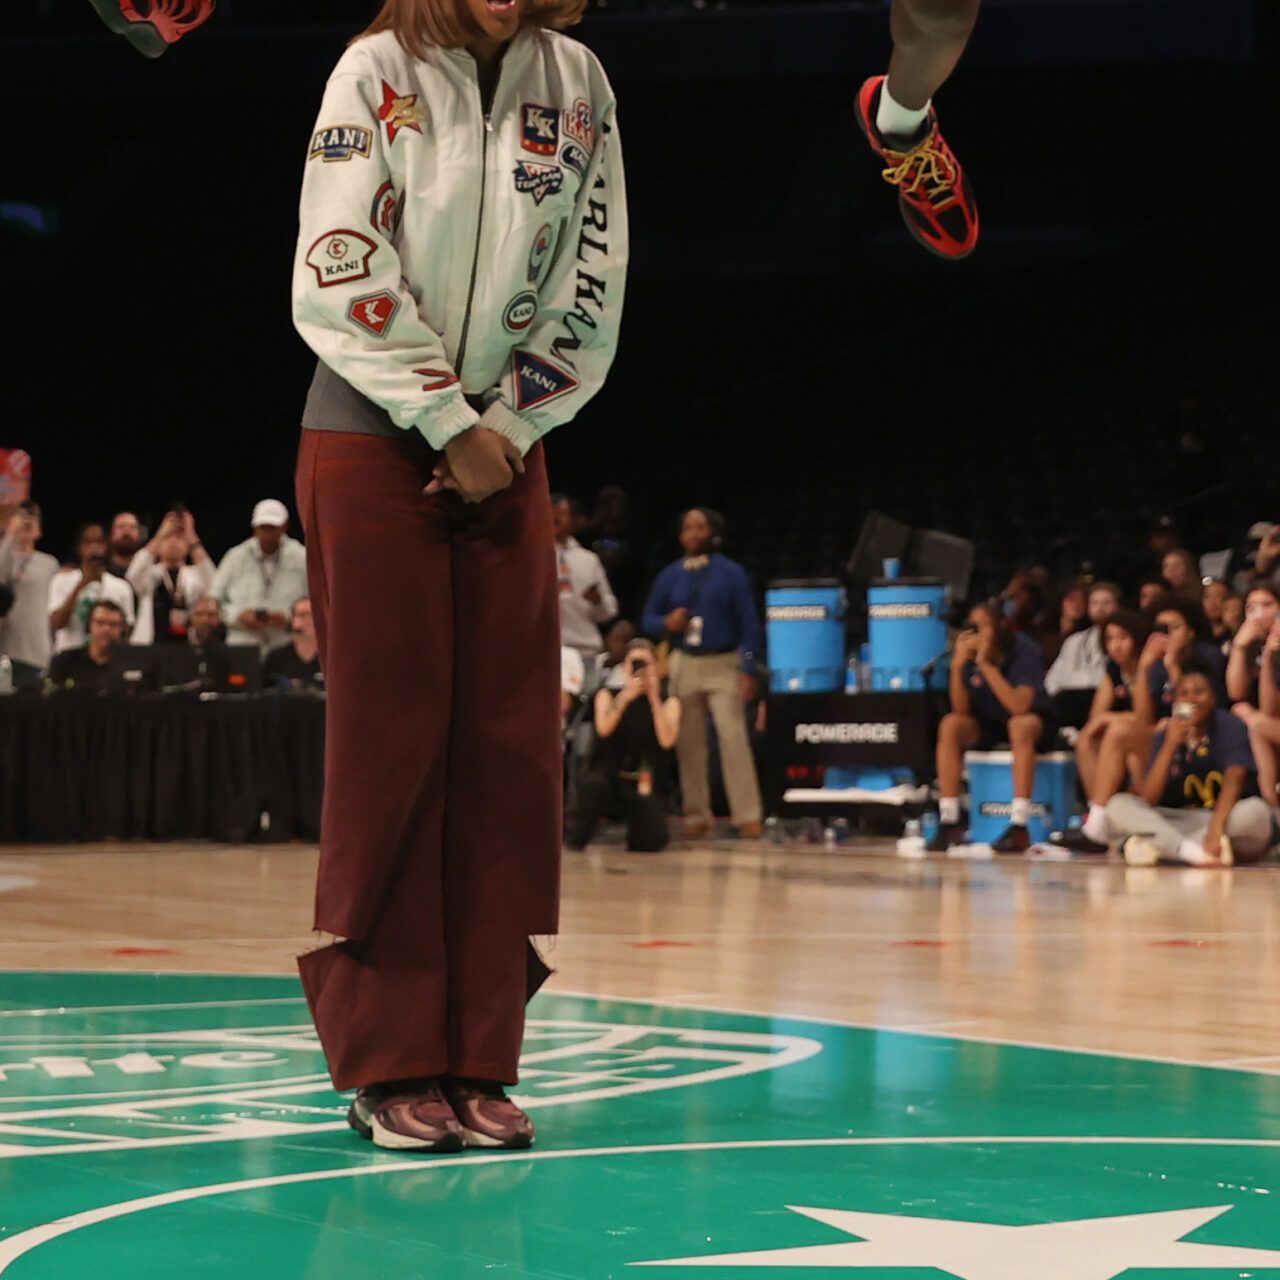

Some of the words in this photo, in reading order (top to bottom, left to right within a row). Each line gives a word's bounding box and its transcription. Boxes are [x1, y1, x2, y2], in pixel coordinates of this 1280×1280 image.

[313, 128, 366, 150] KANI
[325, 260, 360, 275] KANI
[520, 364, 558, 392] KANI
[795, 722, 898, 744] POWERADE
